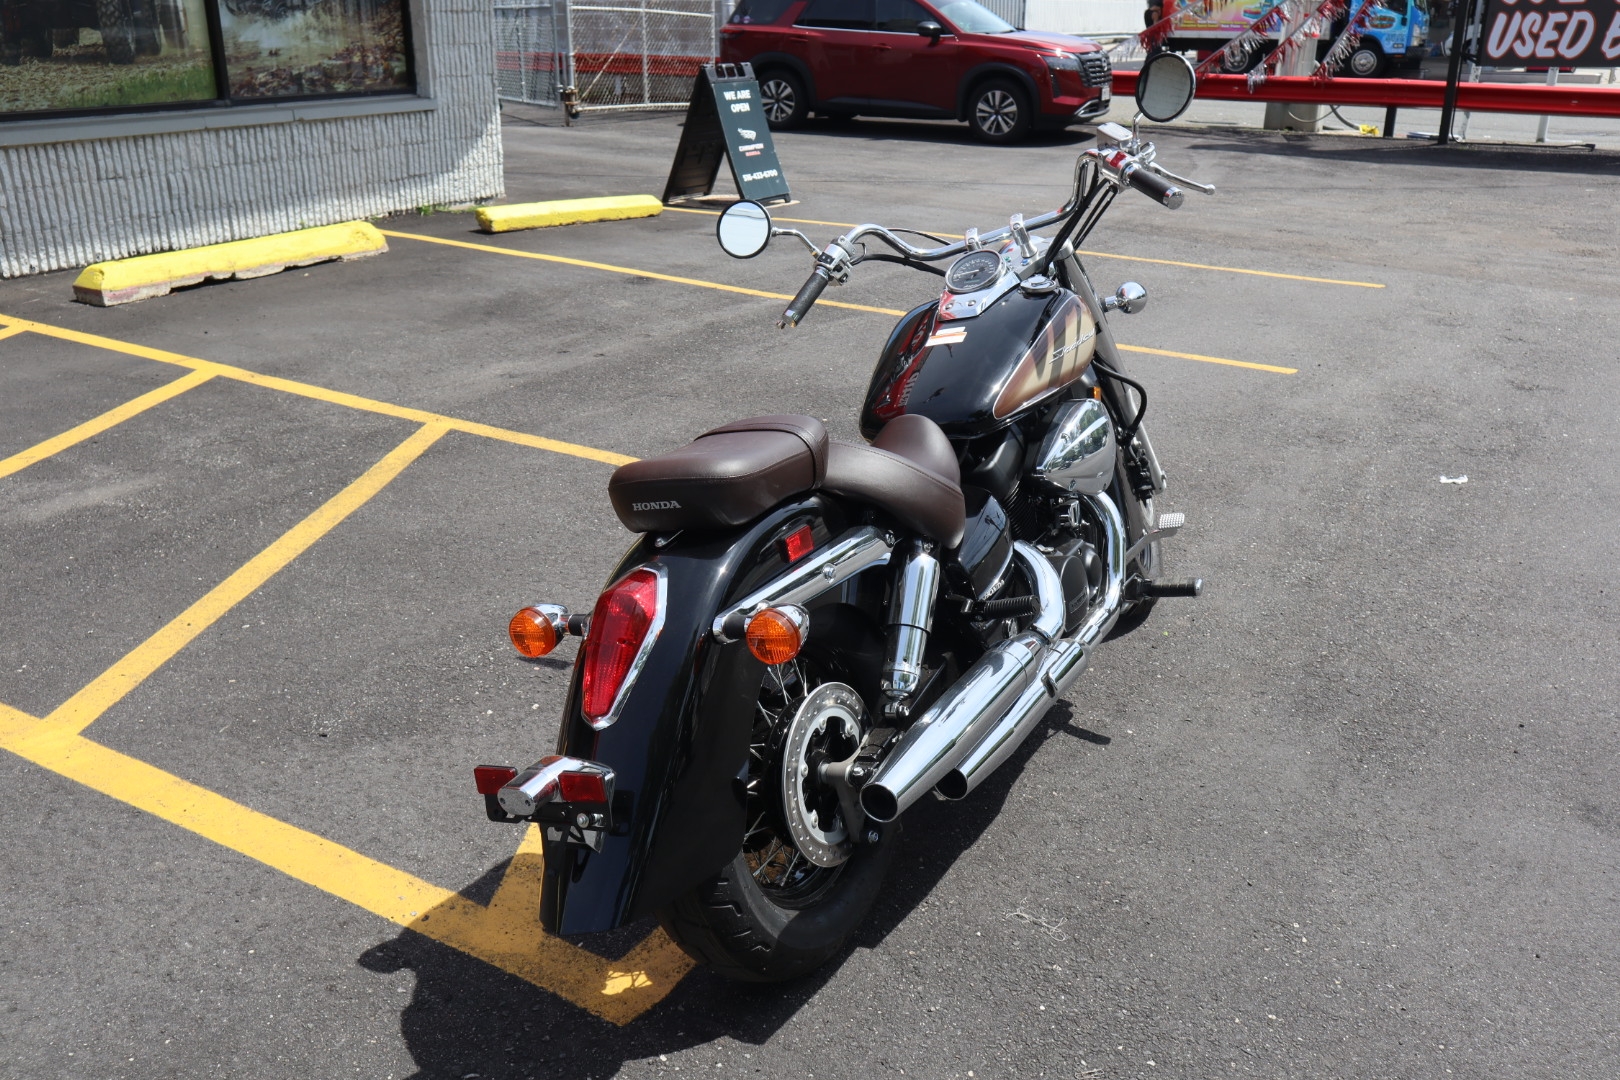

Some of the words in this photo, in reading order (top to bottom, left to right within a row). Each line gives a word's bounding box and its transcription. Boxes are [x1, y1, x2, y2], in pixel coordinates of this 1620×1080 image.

[1486, 9, 1596, 59] USED
[724, 91, 737, 100] WE
[737, 90, 751, 99] ARE
[731, 103, 750, 113] OPEN
[631, 500, 682, 512] HONDA
